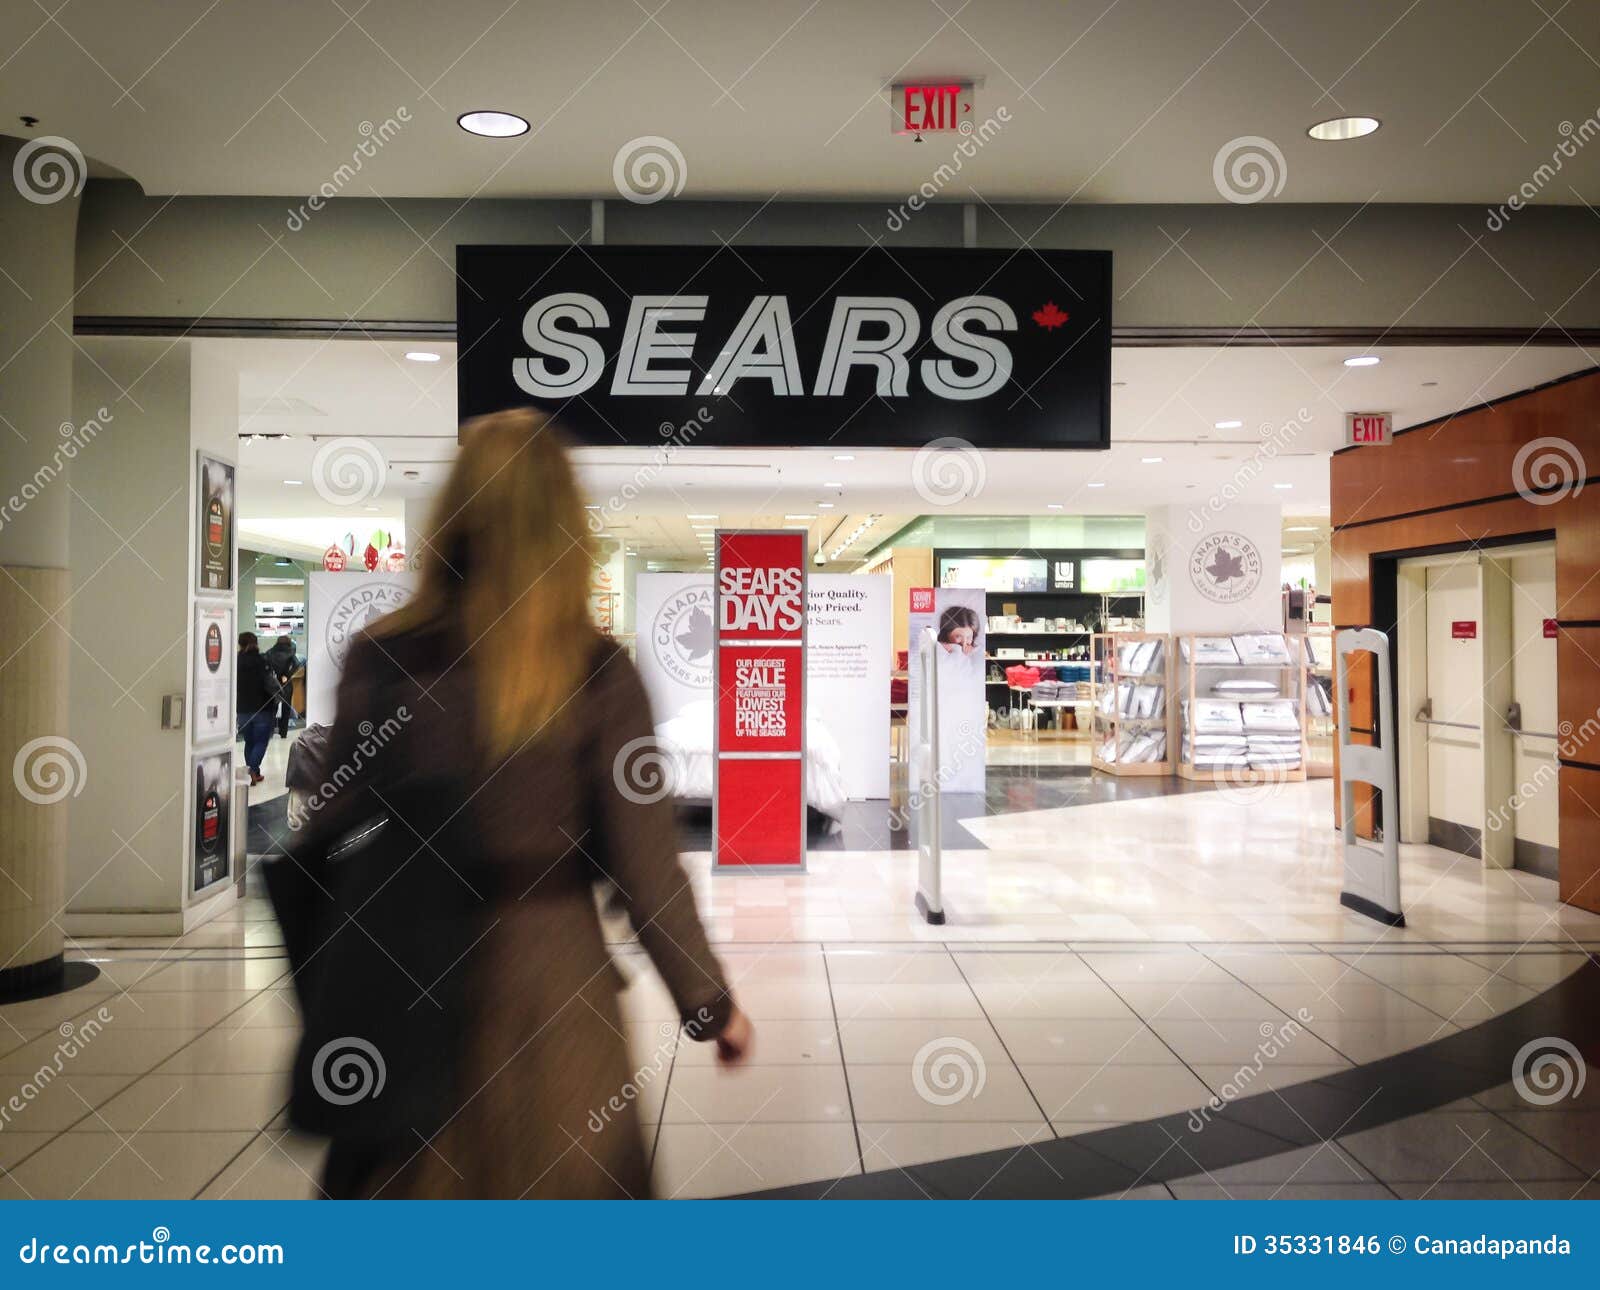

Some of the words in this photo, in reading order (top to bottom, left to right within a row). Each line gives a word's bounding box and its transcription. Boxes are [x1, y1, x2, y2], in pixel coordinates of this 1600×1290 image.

[905, 86, 961, 129] EXIT
[512, 292, 1019, 402] SEARS
[1353, 417, 1385, 442] EXIT
[1193, 535, 1241, 574] CANADA'S
[1241, 544, 1258, 575] BEST
[719, 567, 802, 595] SEARS
[827, 589, 868, 600] Quality.
[332, 588, 403, 645] CANADA'S
[658, 590, 711, 646] CANADA
[719, 594, 802, 631] DAYS
[807, 603, 824, 614] bly
[825, 603, 862, 613] Priced.
[736, 658, 753, 667] OUR
[753, 658, 786, 667] BIGGEST
[736, 667, 786, 688] SALE
[736, 697, 786, 711] LOWEST
[771, 689, 786, 698] OUR
[736, 710, 786, 729] PRICES
[736, 728, 745, 737] OF
[745, 728, 759, 737] THE
[758, 728, 786, 737] SEASON
